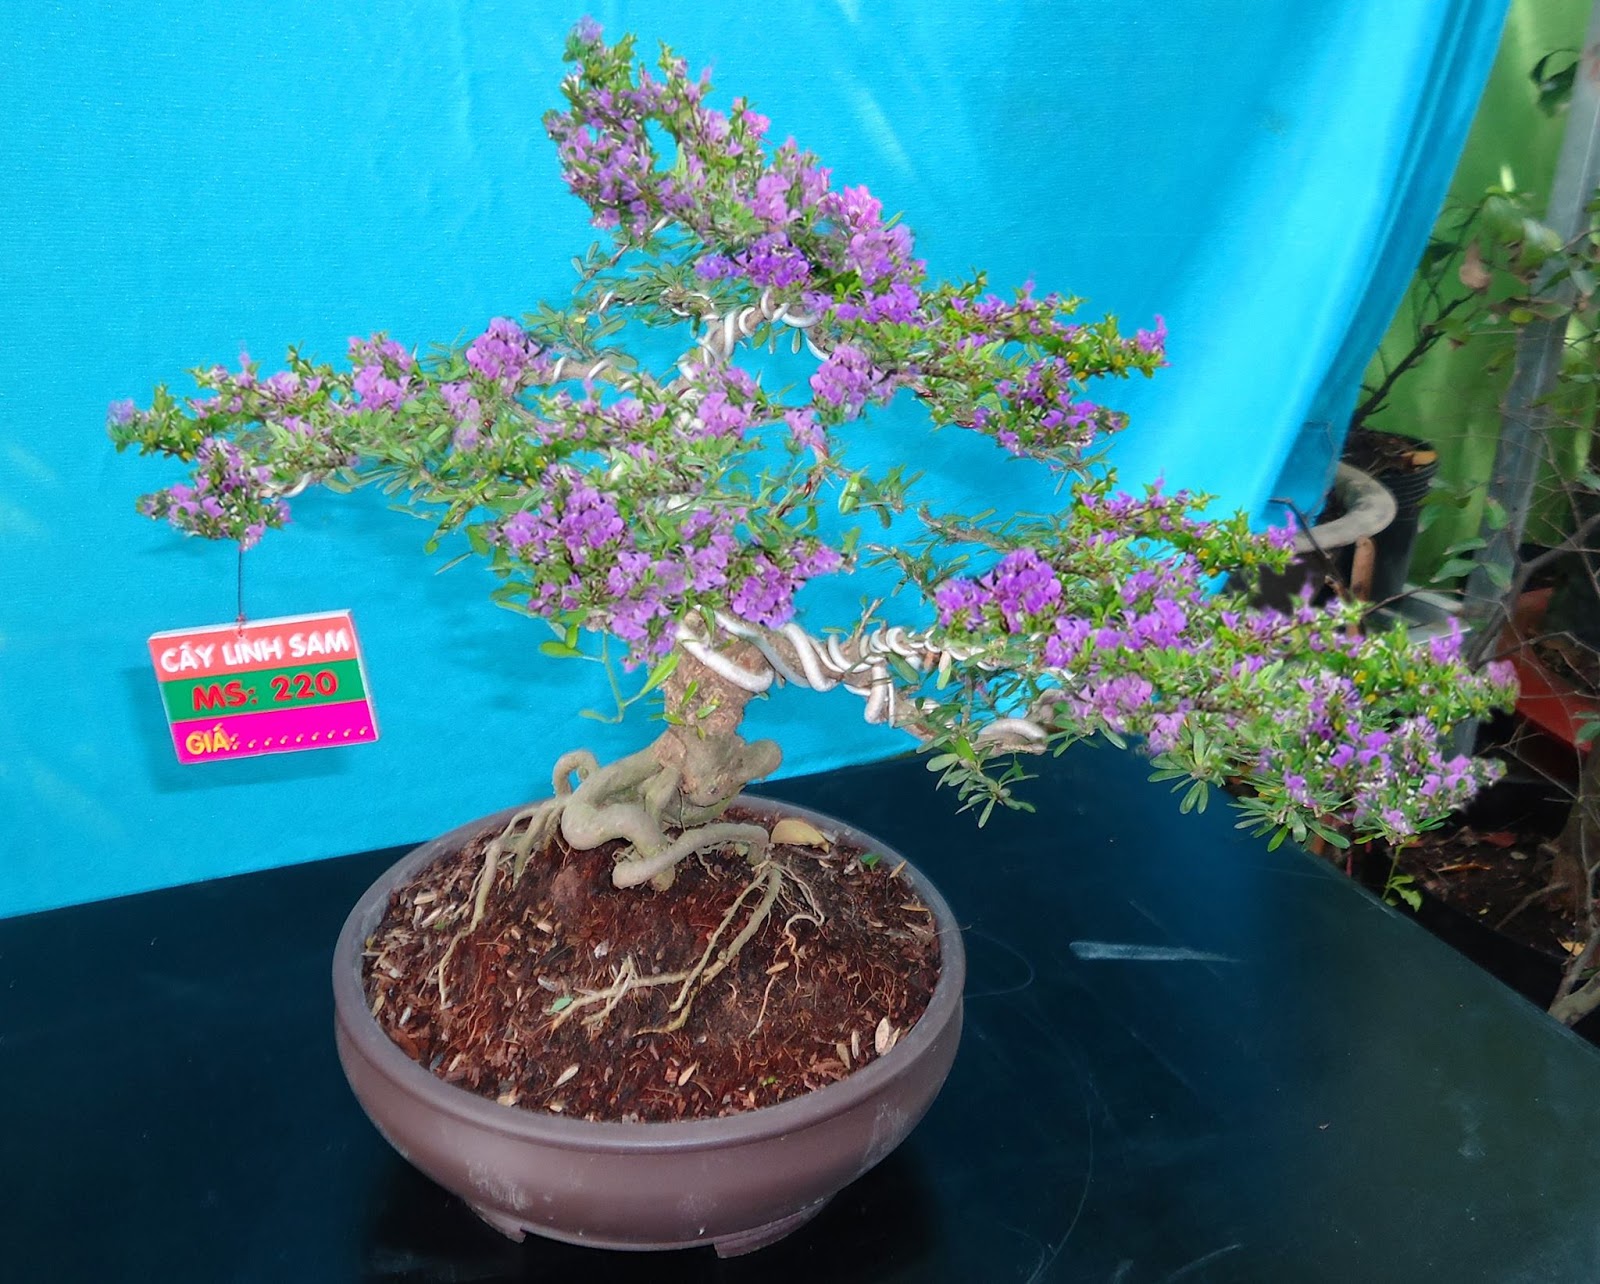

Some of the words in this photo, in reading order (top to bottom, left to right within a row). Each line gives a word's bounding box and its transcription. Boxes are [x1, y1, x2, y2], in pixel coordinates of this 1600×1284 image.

[160, 642, 214, 673] CÂY
[222, 637, 283, 666] LINH
[288, 628, 349, 658] SAM
[193, 681, 257, 712] MS:
[270, 671, 338, 701] 220
